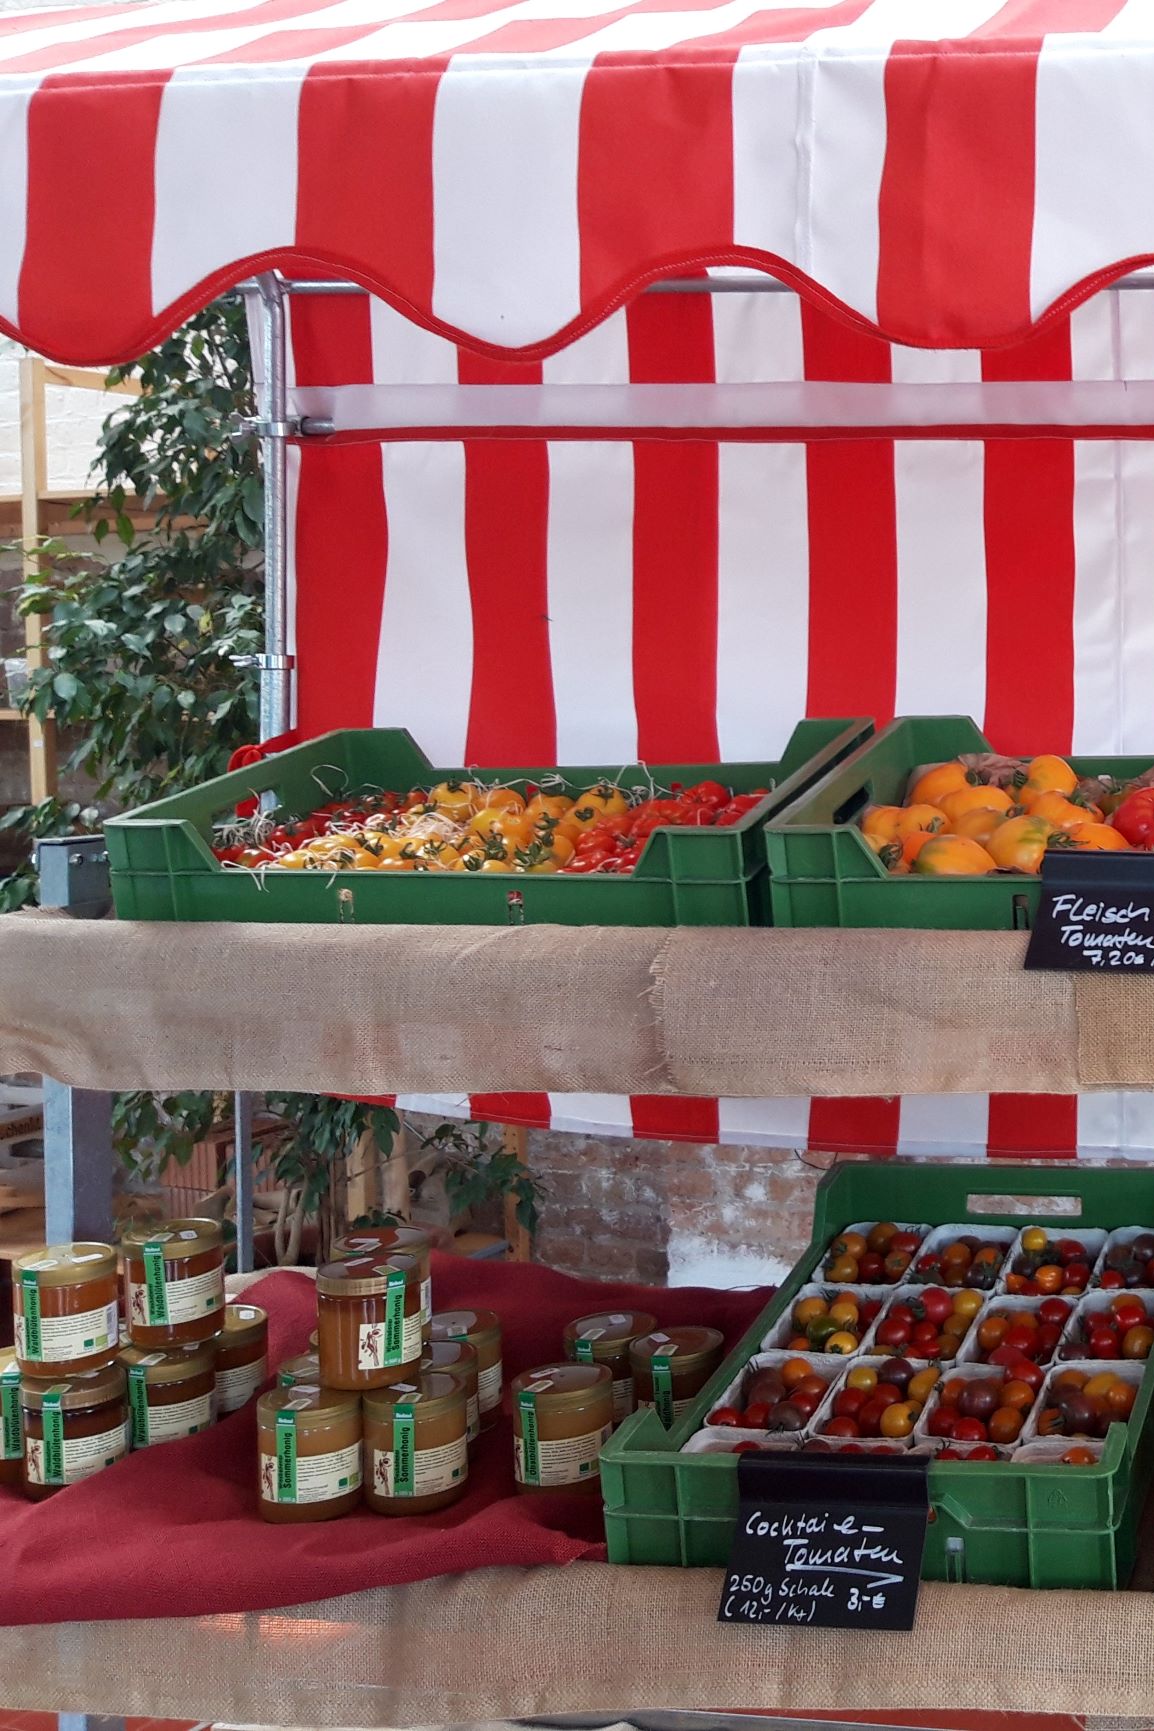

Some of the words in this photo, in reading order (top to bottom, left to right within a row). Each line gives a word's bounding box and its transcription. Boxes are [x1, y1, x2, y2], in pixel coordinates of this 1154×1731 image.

[392, 1294, 402, 1351] Sommerhonig
[284, 1432, 293, 1489] Sommerhonig
[400, 1426, 410, 1483] Sommerhonig
[783, 1538, 904, 1565] Tomaten
[779, 1577, 835, 1598] Schale
